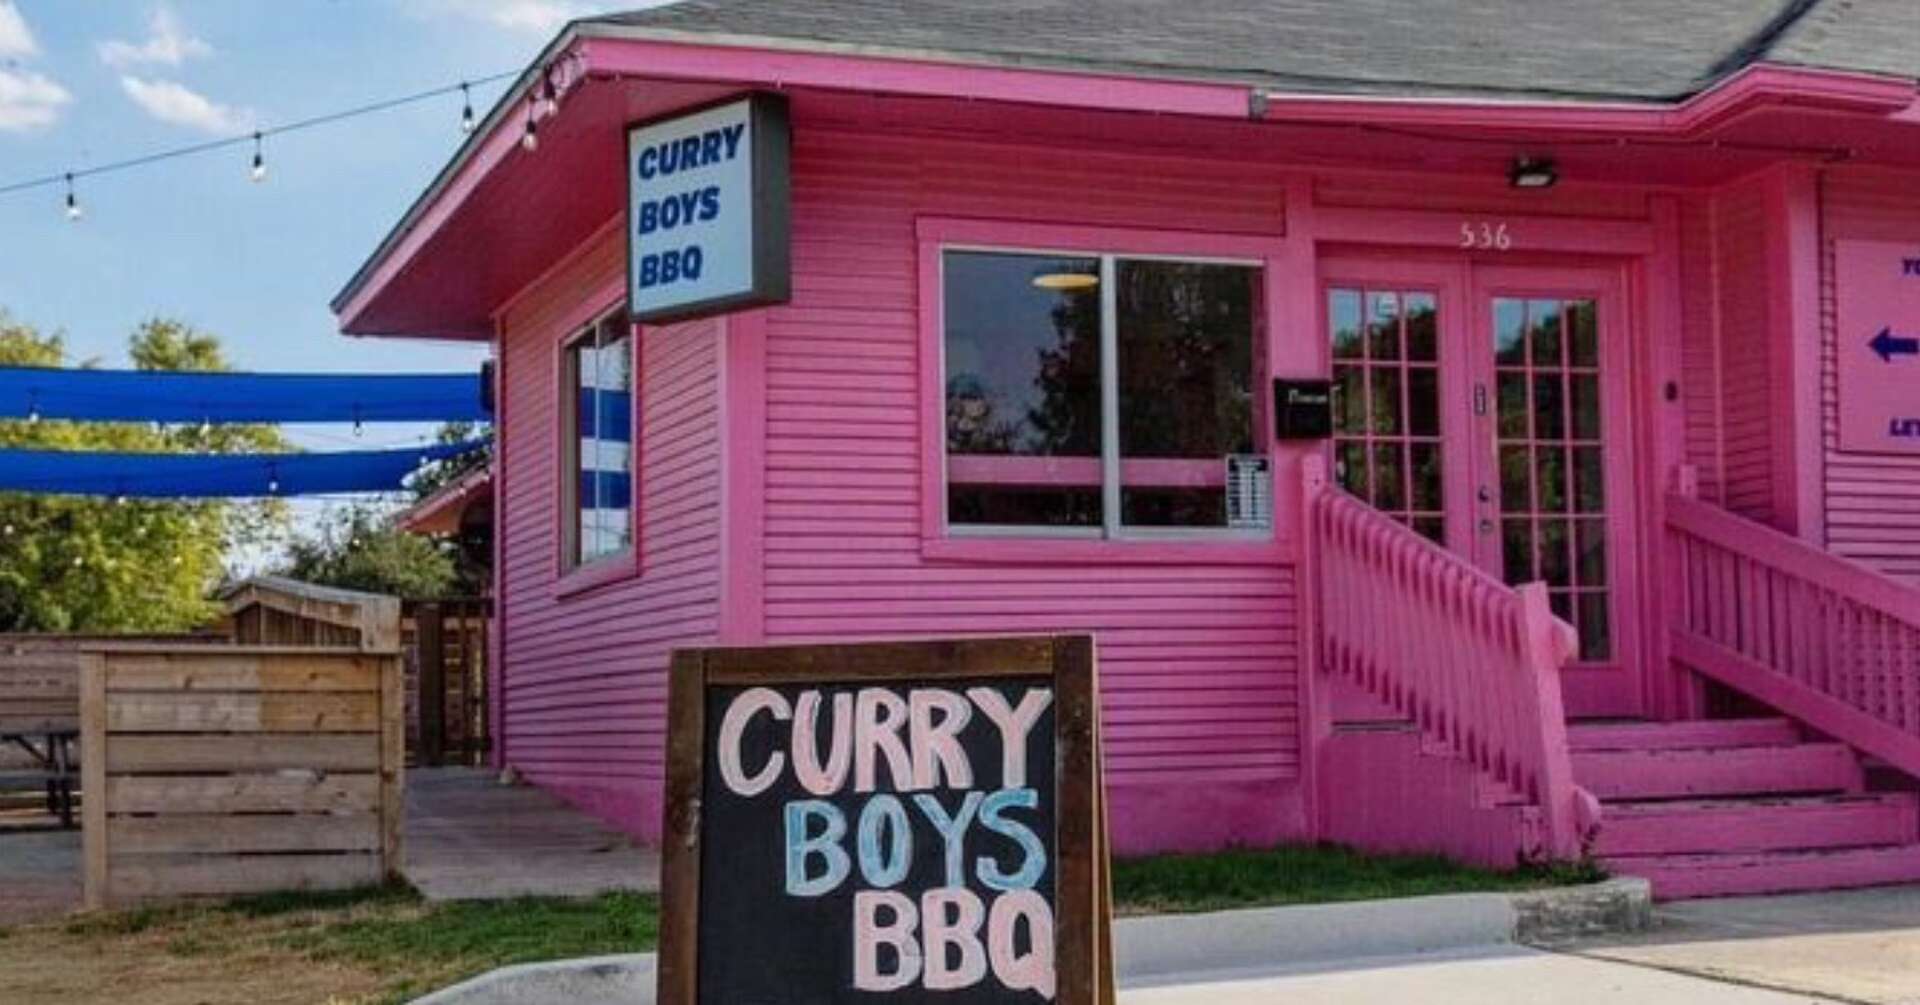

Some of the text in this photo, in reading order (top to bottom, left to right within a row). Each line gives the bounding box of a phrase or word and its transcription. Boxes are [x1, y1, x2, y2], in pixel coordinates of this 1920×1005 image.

[639, 124, 744, 179] CURRY
[639, 187, 720, 234] BOYS
[1460, 221, 1510, 250] 536
[639, 246, 702, 288] BBQ
[717, 686, 1053, 796] CURRY
[784, 788, 1047, 896] BOYS
[853, 887, 1056, 1000] BBQ
